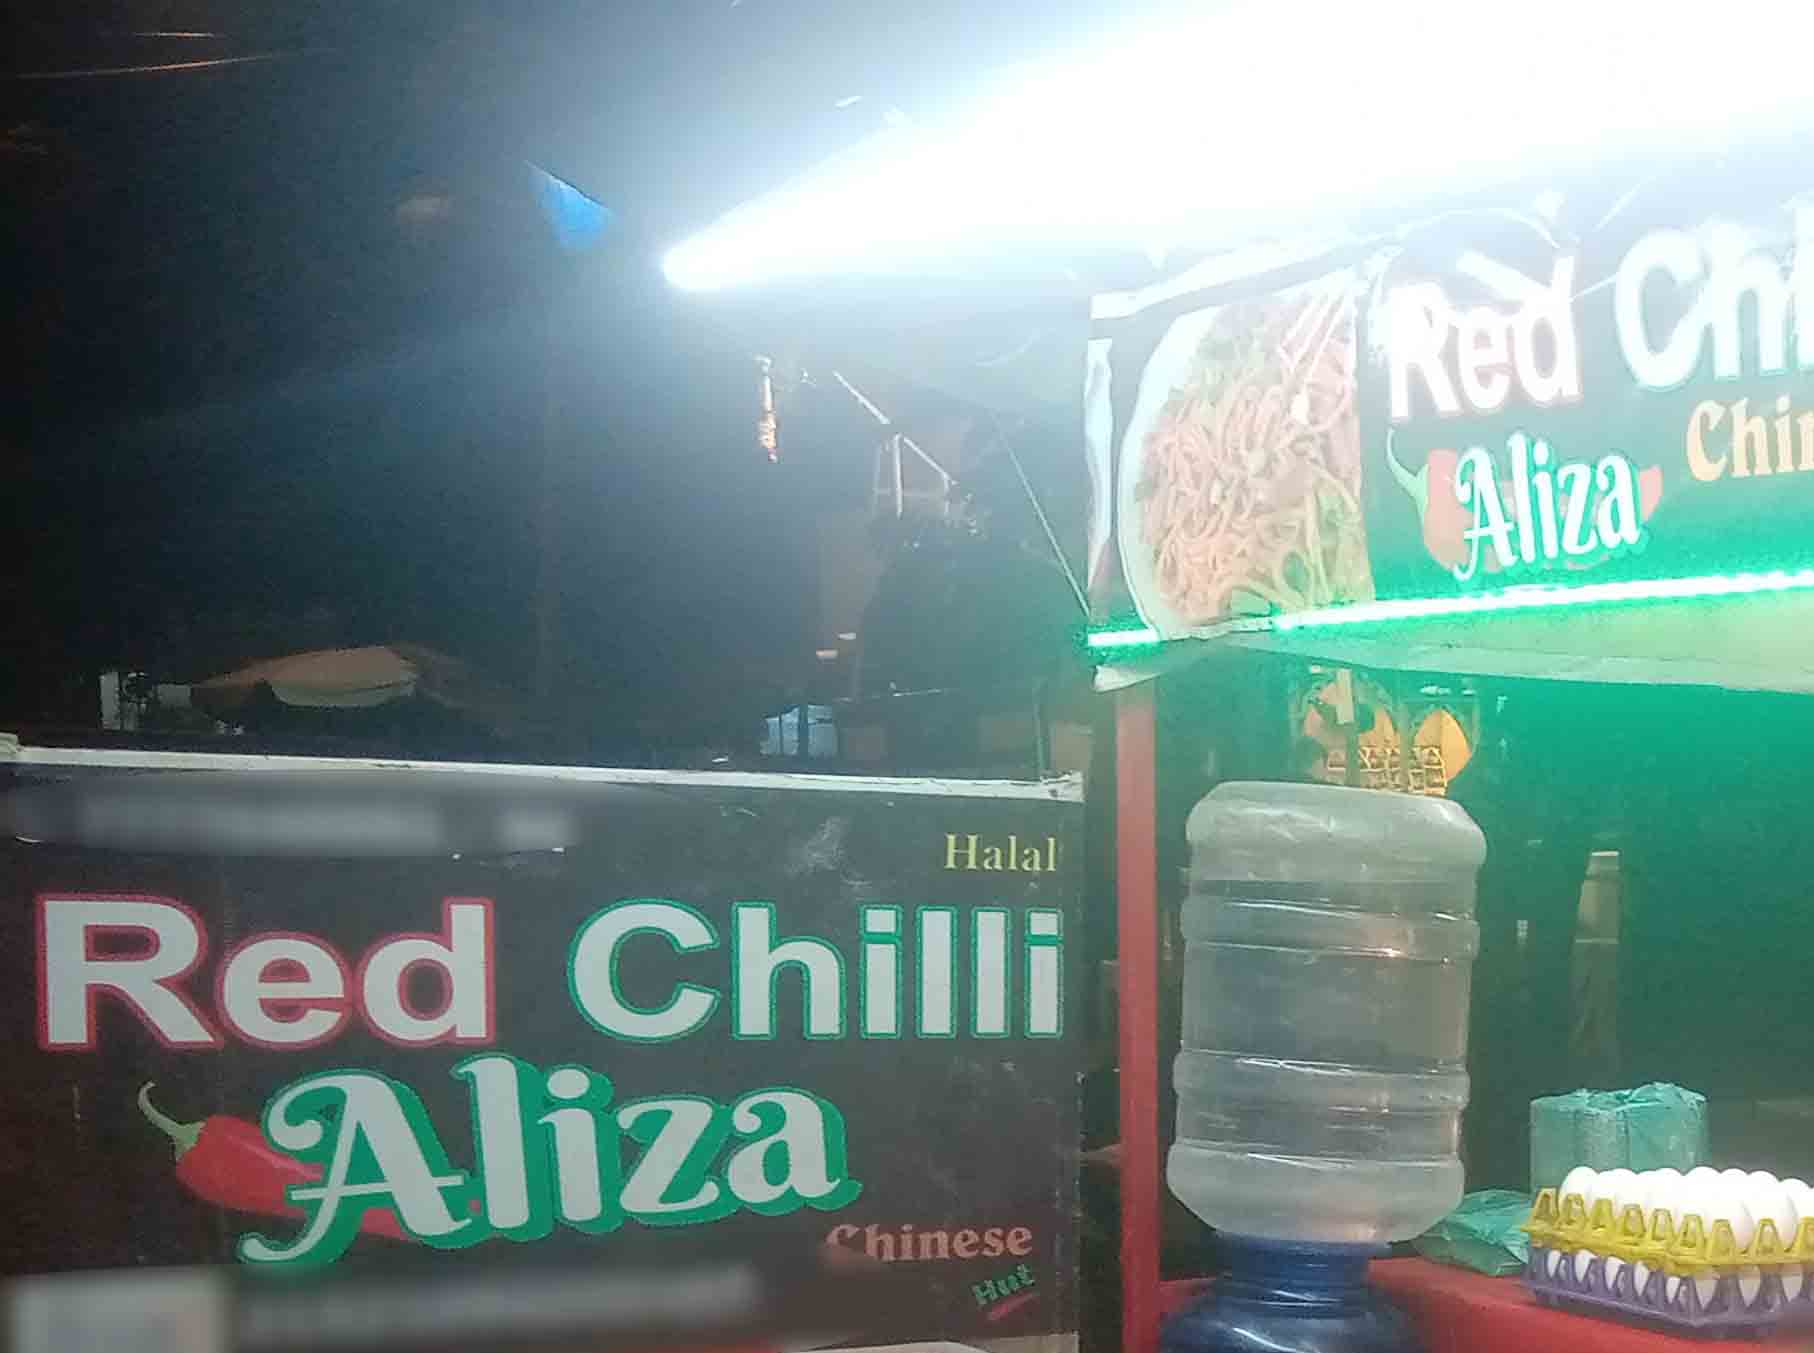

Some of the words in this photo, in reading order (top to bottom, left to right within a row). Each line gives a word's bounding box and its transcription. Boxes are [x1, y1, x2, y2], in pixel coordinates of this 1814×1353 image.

[1387, 252, 1583, 422] Red
[1452, 430, 1645, 582] Aliza
[943, 834, 1057, 873] Halal
[37, 895, 495, 1050] Red
[567, 898, 1064, 1041] Chilli
[238, 1053, 858, 1264] Aliza
[825, 1223, 1034, 1262] Chinese
